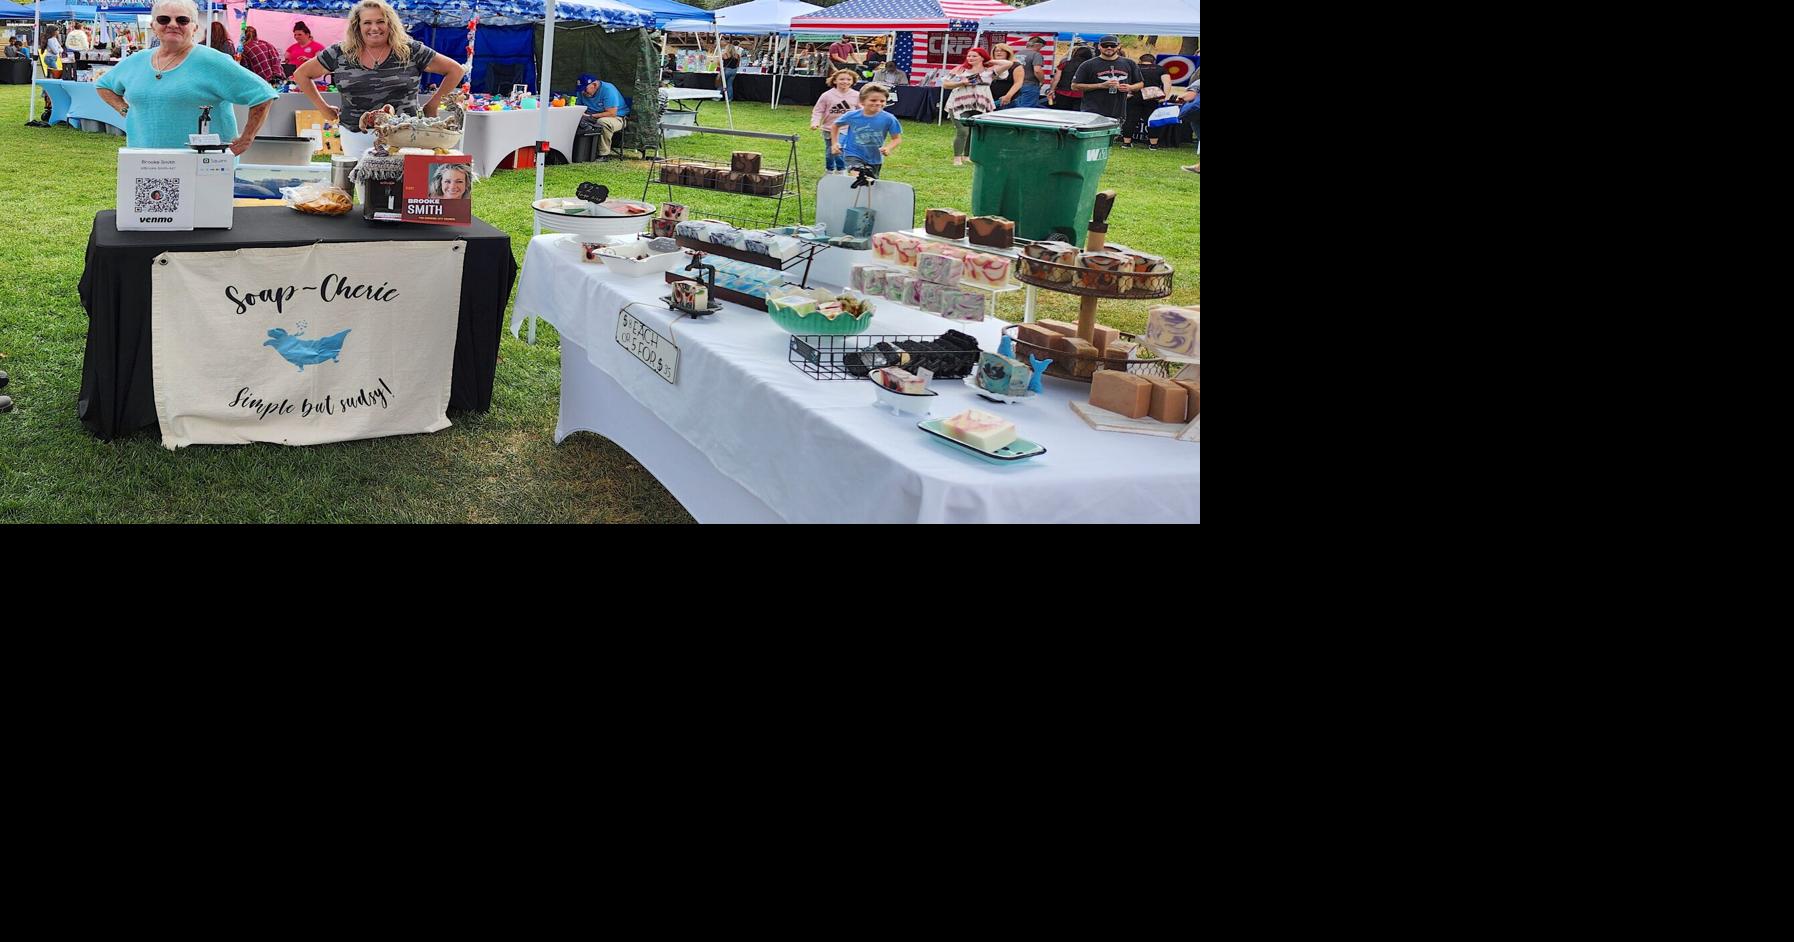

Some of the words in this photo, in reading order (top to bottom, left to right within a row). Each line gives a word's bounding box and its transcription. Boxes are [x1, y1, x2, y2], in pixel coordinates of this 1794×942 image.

[407, 204, 443, 215] SMITH
[632, 320, 659, 350] EACH
[637, 341, 657, 368] FOR
[228, 386, 296, 421] Simple
[301, 394, 335, 418] but
[340, 377, 395, 413] sudsy!
